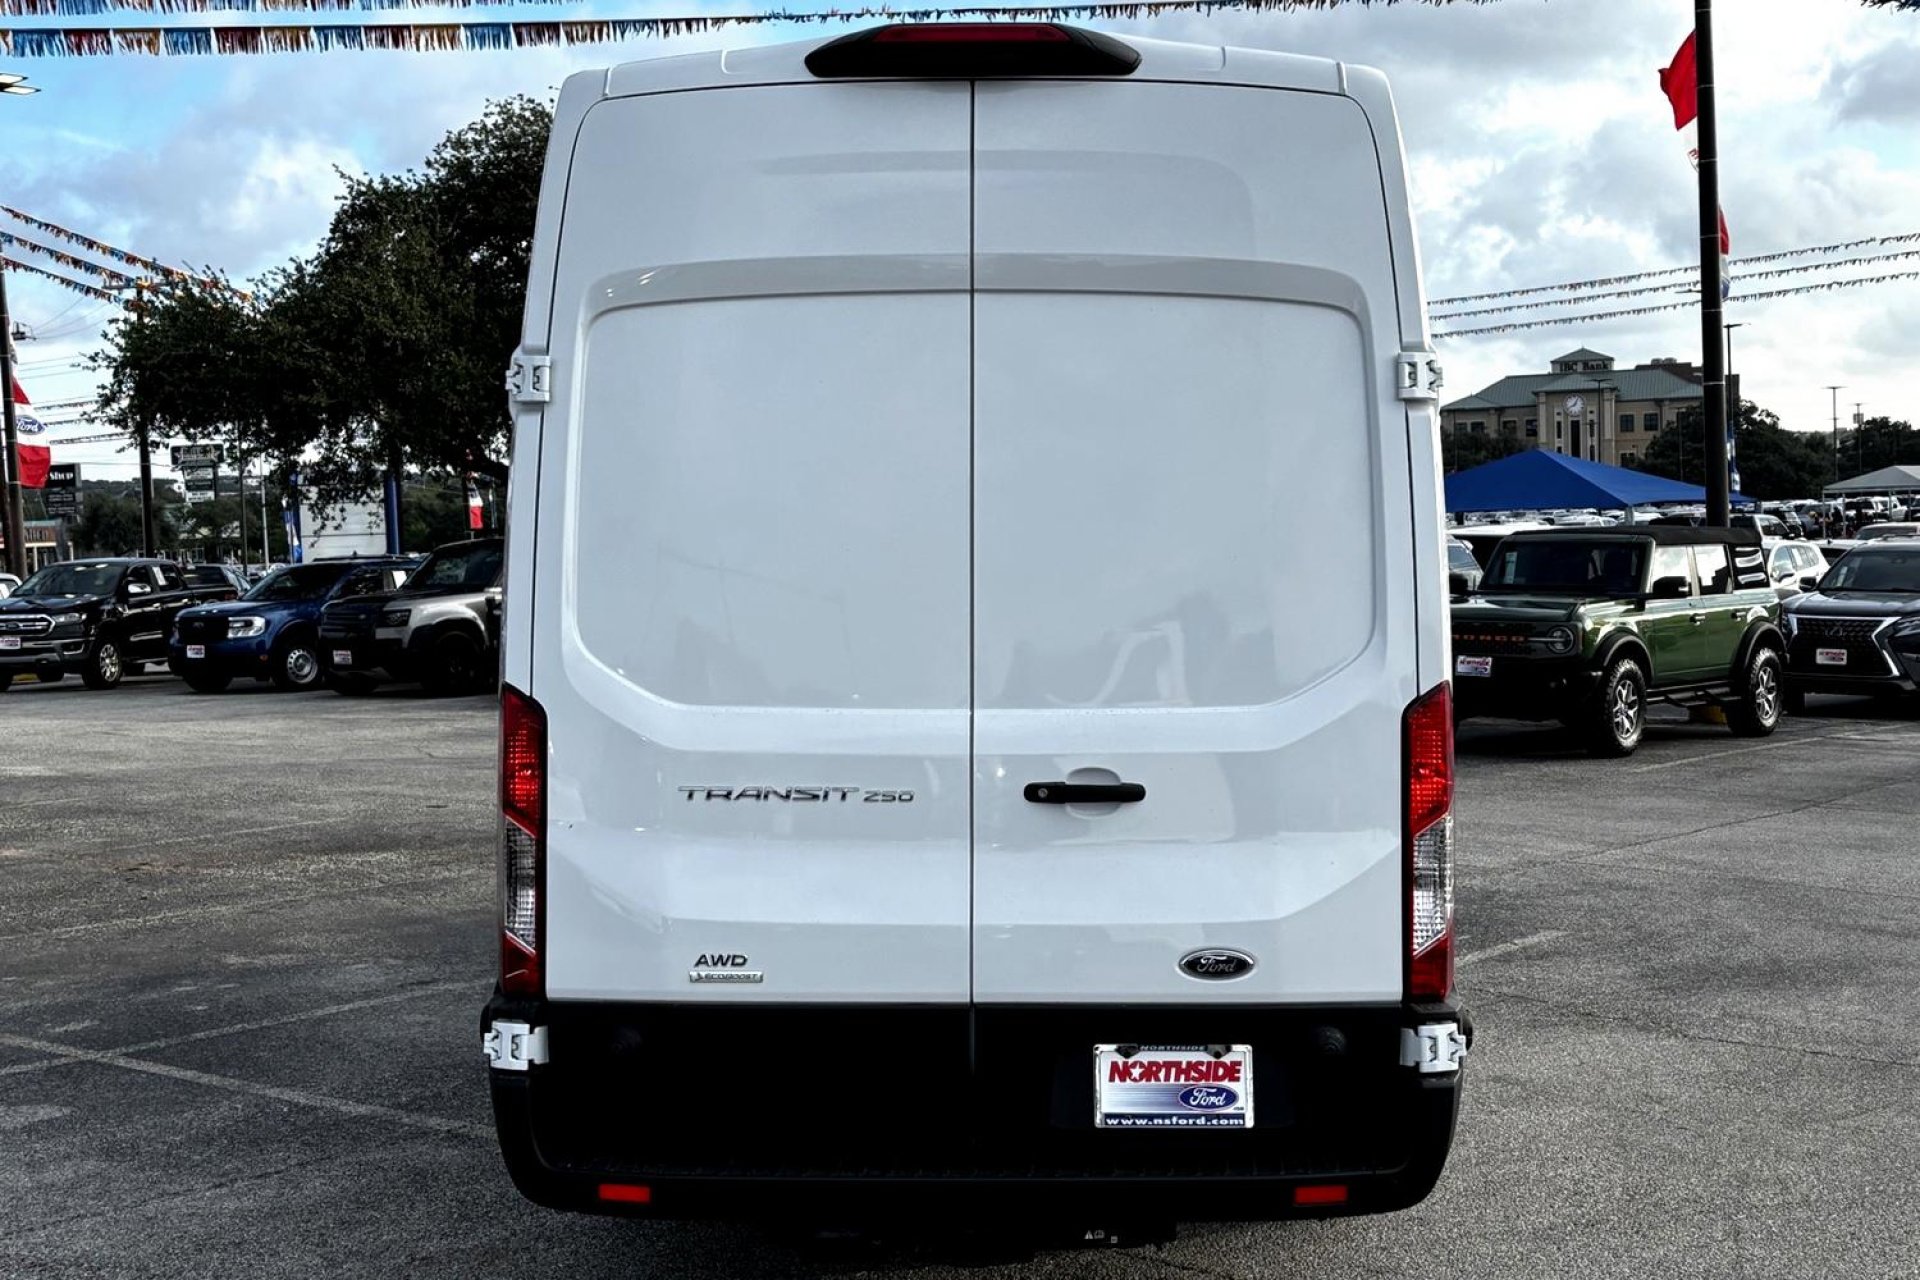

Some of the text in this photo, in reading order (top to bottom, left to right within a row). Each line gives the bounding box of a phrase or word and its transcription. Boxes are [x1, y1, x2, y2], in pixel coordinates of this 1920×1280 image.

[16, 418, 38, 432] Ford
[677, 785, 915, 802] TRANSIT 250
[694, 954, 748, 967] AWD
[1196, 955, 1237, 973] Ford
[1108, 1060, 1243, 1083] NORTHSIDE
[1189, 1087, 1226, 1106] Ford
[1106, 1116, 1244, 1125] www.nsford.com
